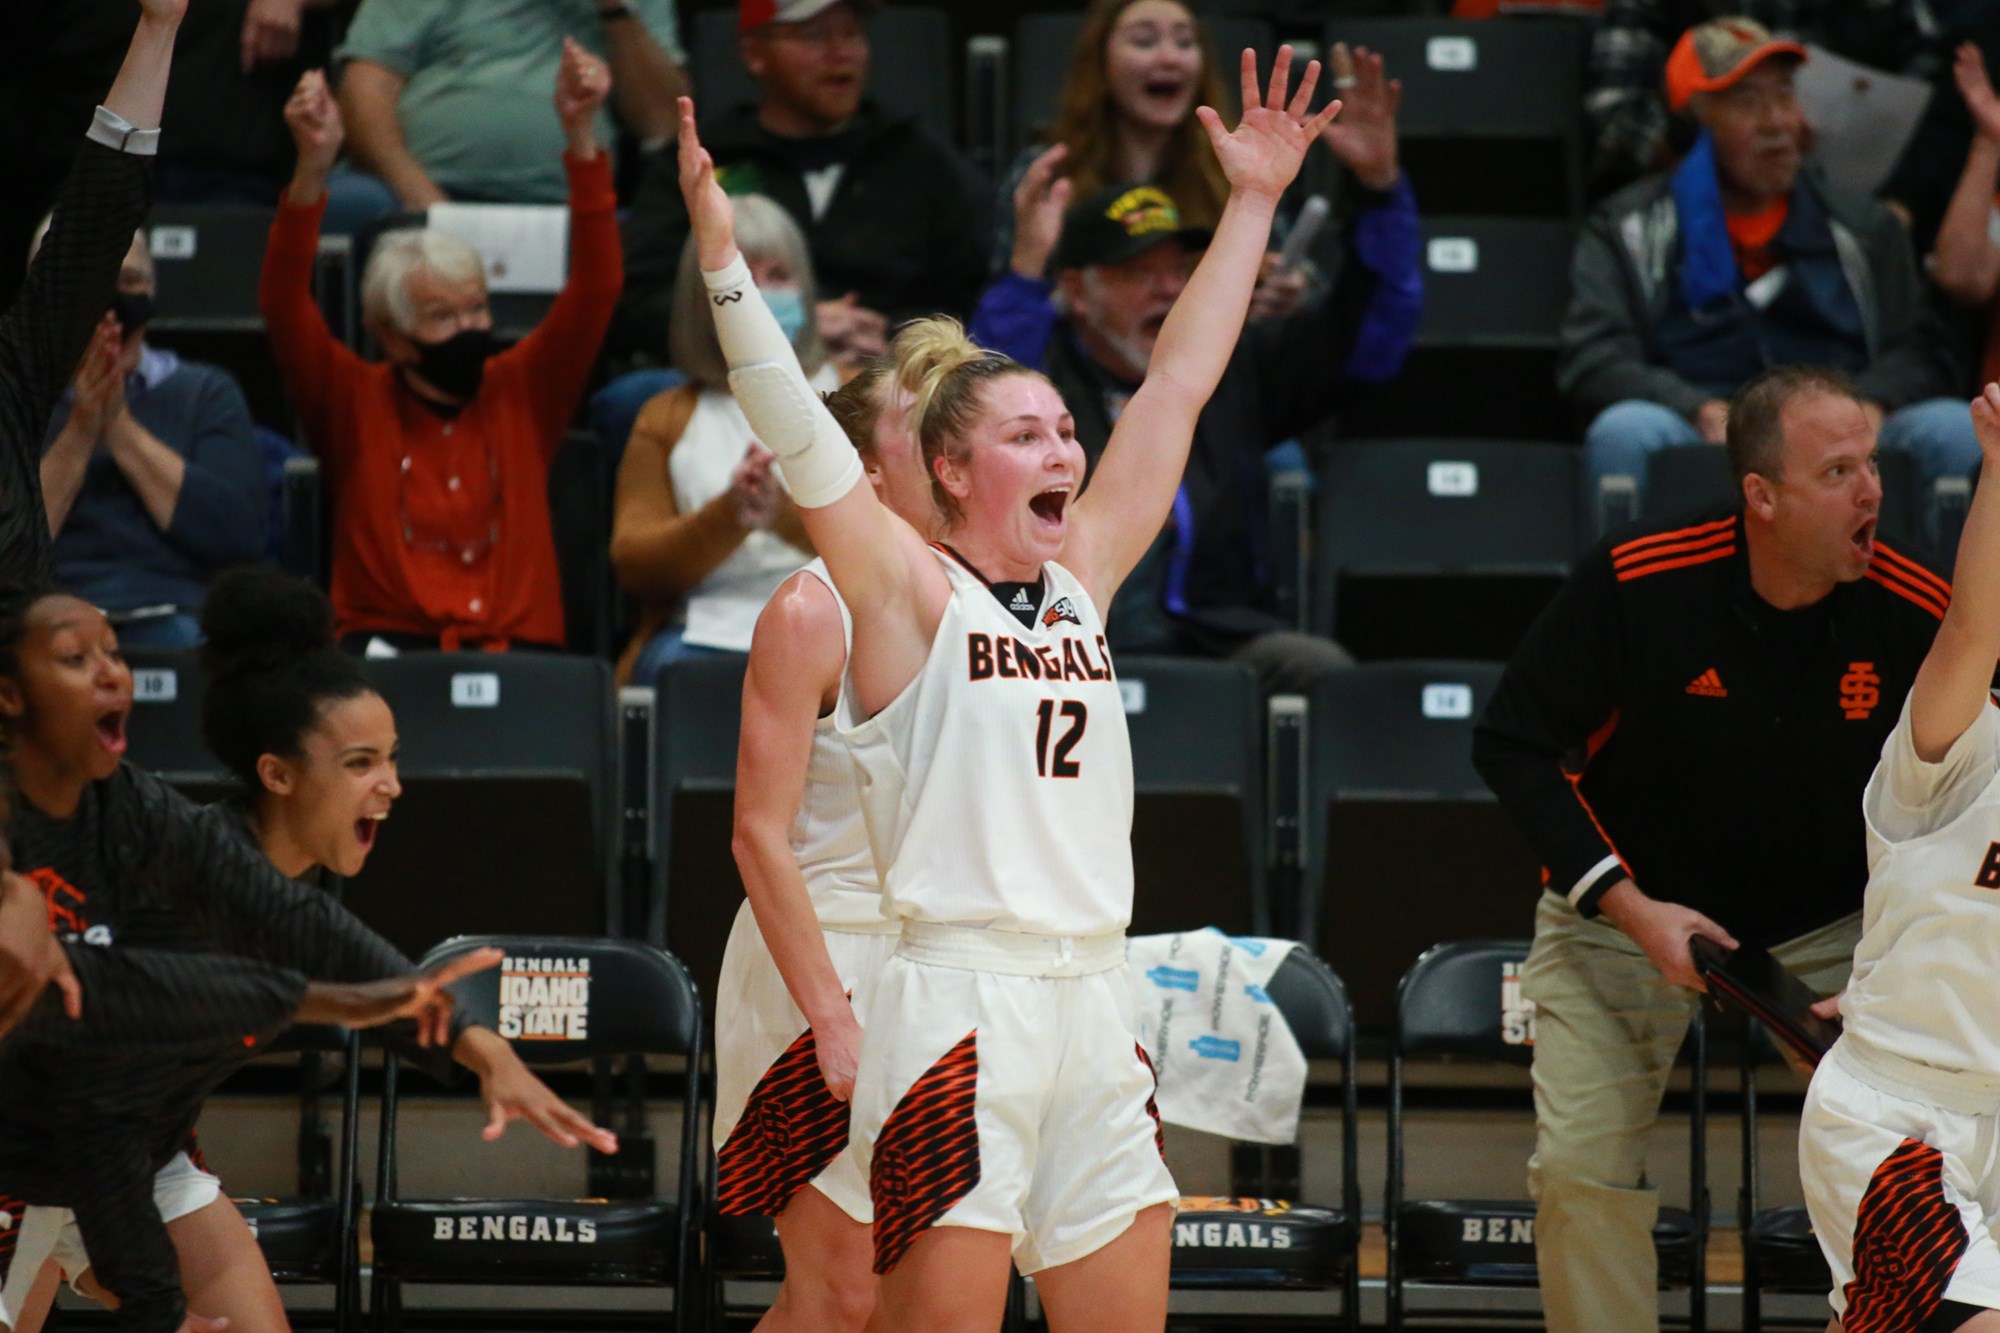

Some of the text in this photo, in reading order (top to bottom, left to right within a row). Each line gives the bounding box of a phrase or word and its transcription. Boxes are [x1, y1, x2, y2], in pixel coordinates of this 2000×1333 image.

[1036, 699, 1088, 778] 12
[501, 957, 590, 972] BENGALS
[500, 976, 589, 1006] IDAHO
[499, 1005, 587, 1039] STATE
[433, 1215, 597, 1243] BENGALS
[1175, 1222, 1291, 1248] NGALS
[1462, 1218, 1534, 1243] BEN
